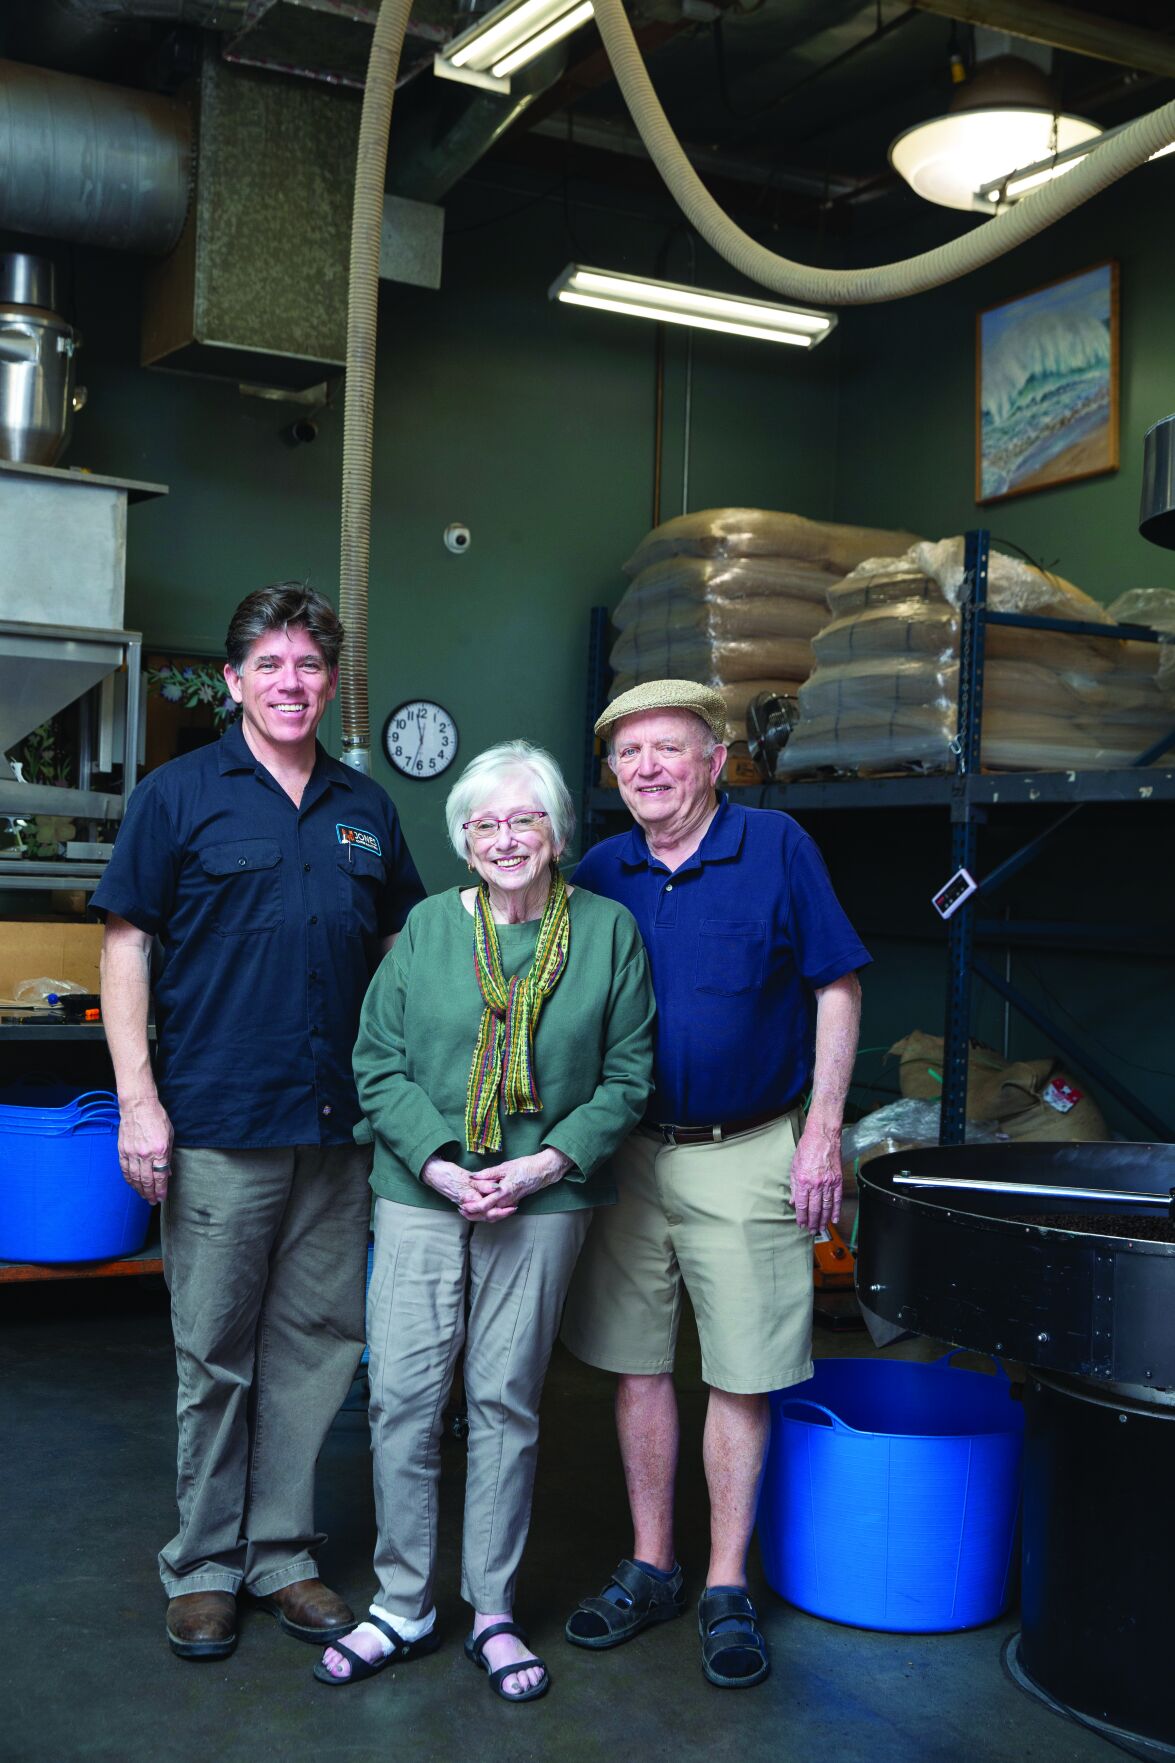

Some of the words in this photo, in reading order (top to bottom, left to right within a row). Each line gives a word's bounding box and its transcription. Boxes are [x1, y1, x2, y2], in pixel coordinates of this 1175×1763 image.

[407, 710, 414, 721] 11
[417, 708, 428, 719] 12
[433, 713, 437, 723] 1
[396, 719, 407, 730] 10
[439, 722, 447, 734] 2
[391, 732, 399, 743] 9
[442, 736, 449, 747] 3
[395, 746, 403, 757] 8
[437, 750, 445, 760] 4
[405, 756, 412, 767] 7
[416, 760, 424, 771] 6
[429, 758, 436, 769] 5
[354, 831, 377, 847] JONES
